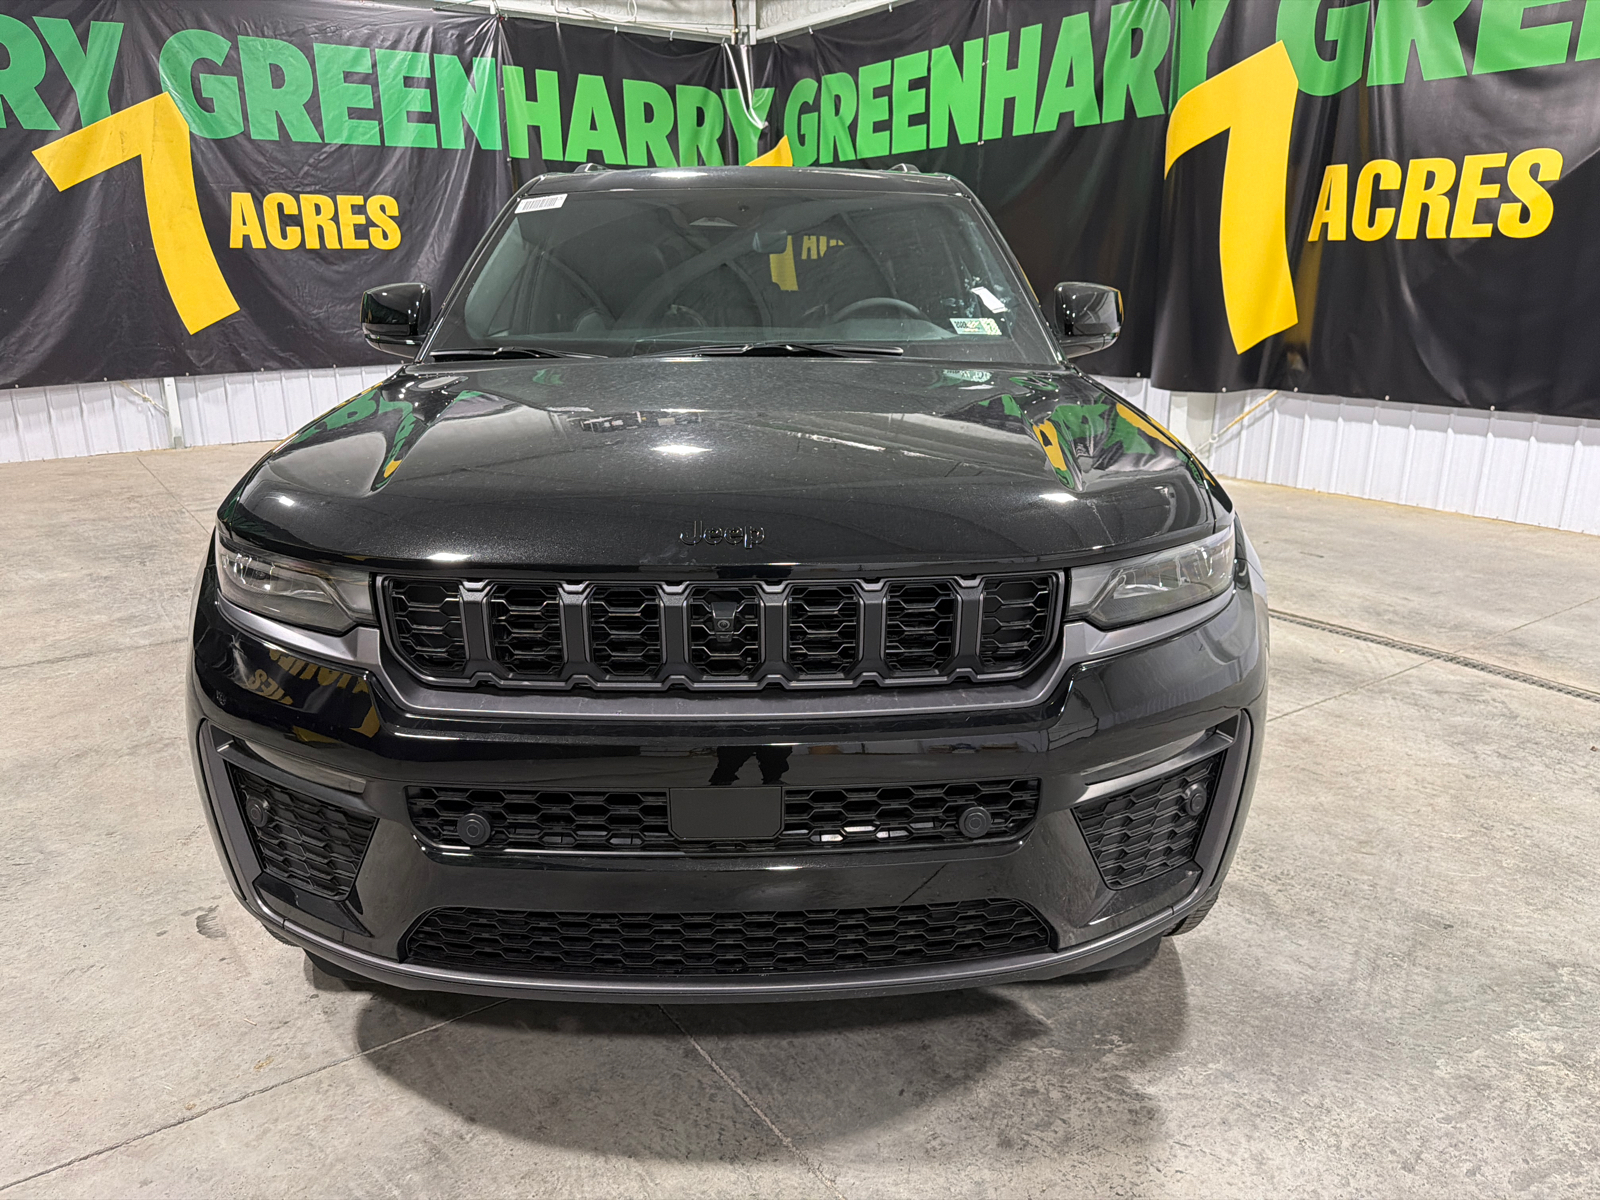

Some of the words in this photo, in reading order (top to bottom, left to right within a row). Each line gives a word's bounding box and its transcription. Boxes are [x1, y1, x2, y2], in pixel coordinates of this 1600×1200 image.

[158, 29, 502, 150] GREEN
[502, 65, 775, 167] HARRY
[784, 37, 983, 167] GREEN
[32, 91, 240, 335] 7
[230, 192, 402, 250] ACRES
[1165, 40, 1299, 355] 7
[1308, 147, 1563, 242] ACRES
[679, 520, 765, 549] Jeep
